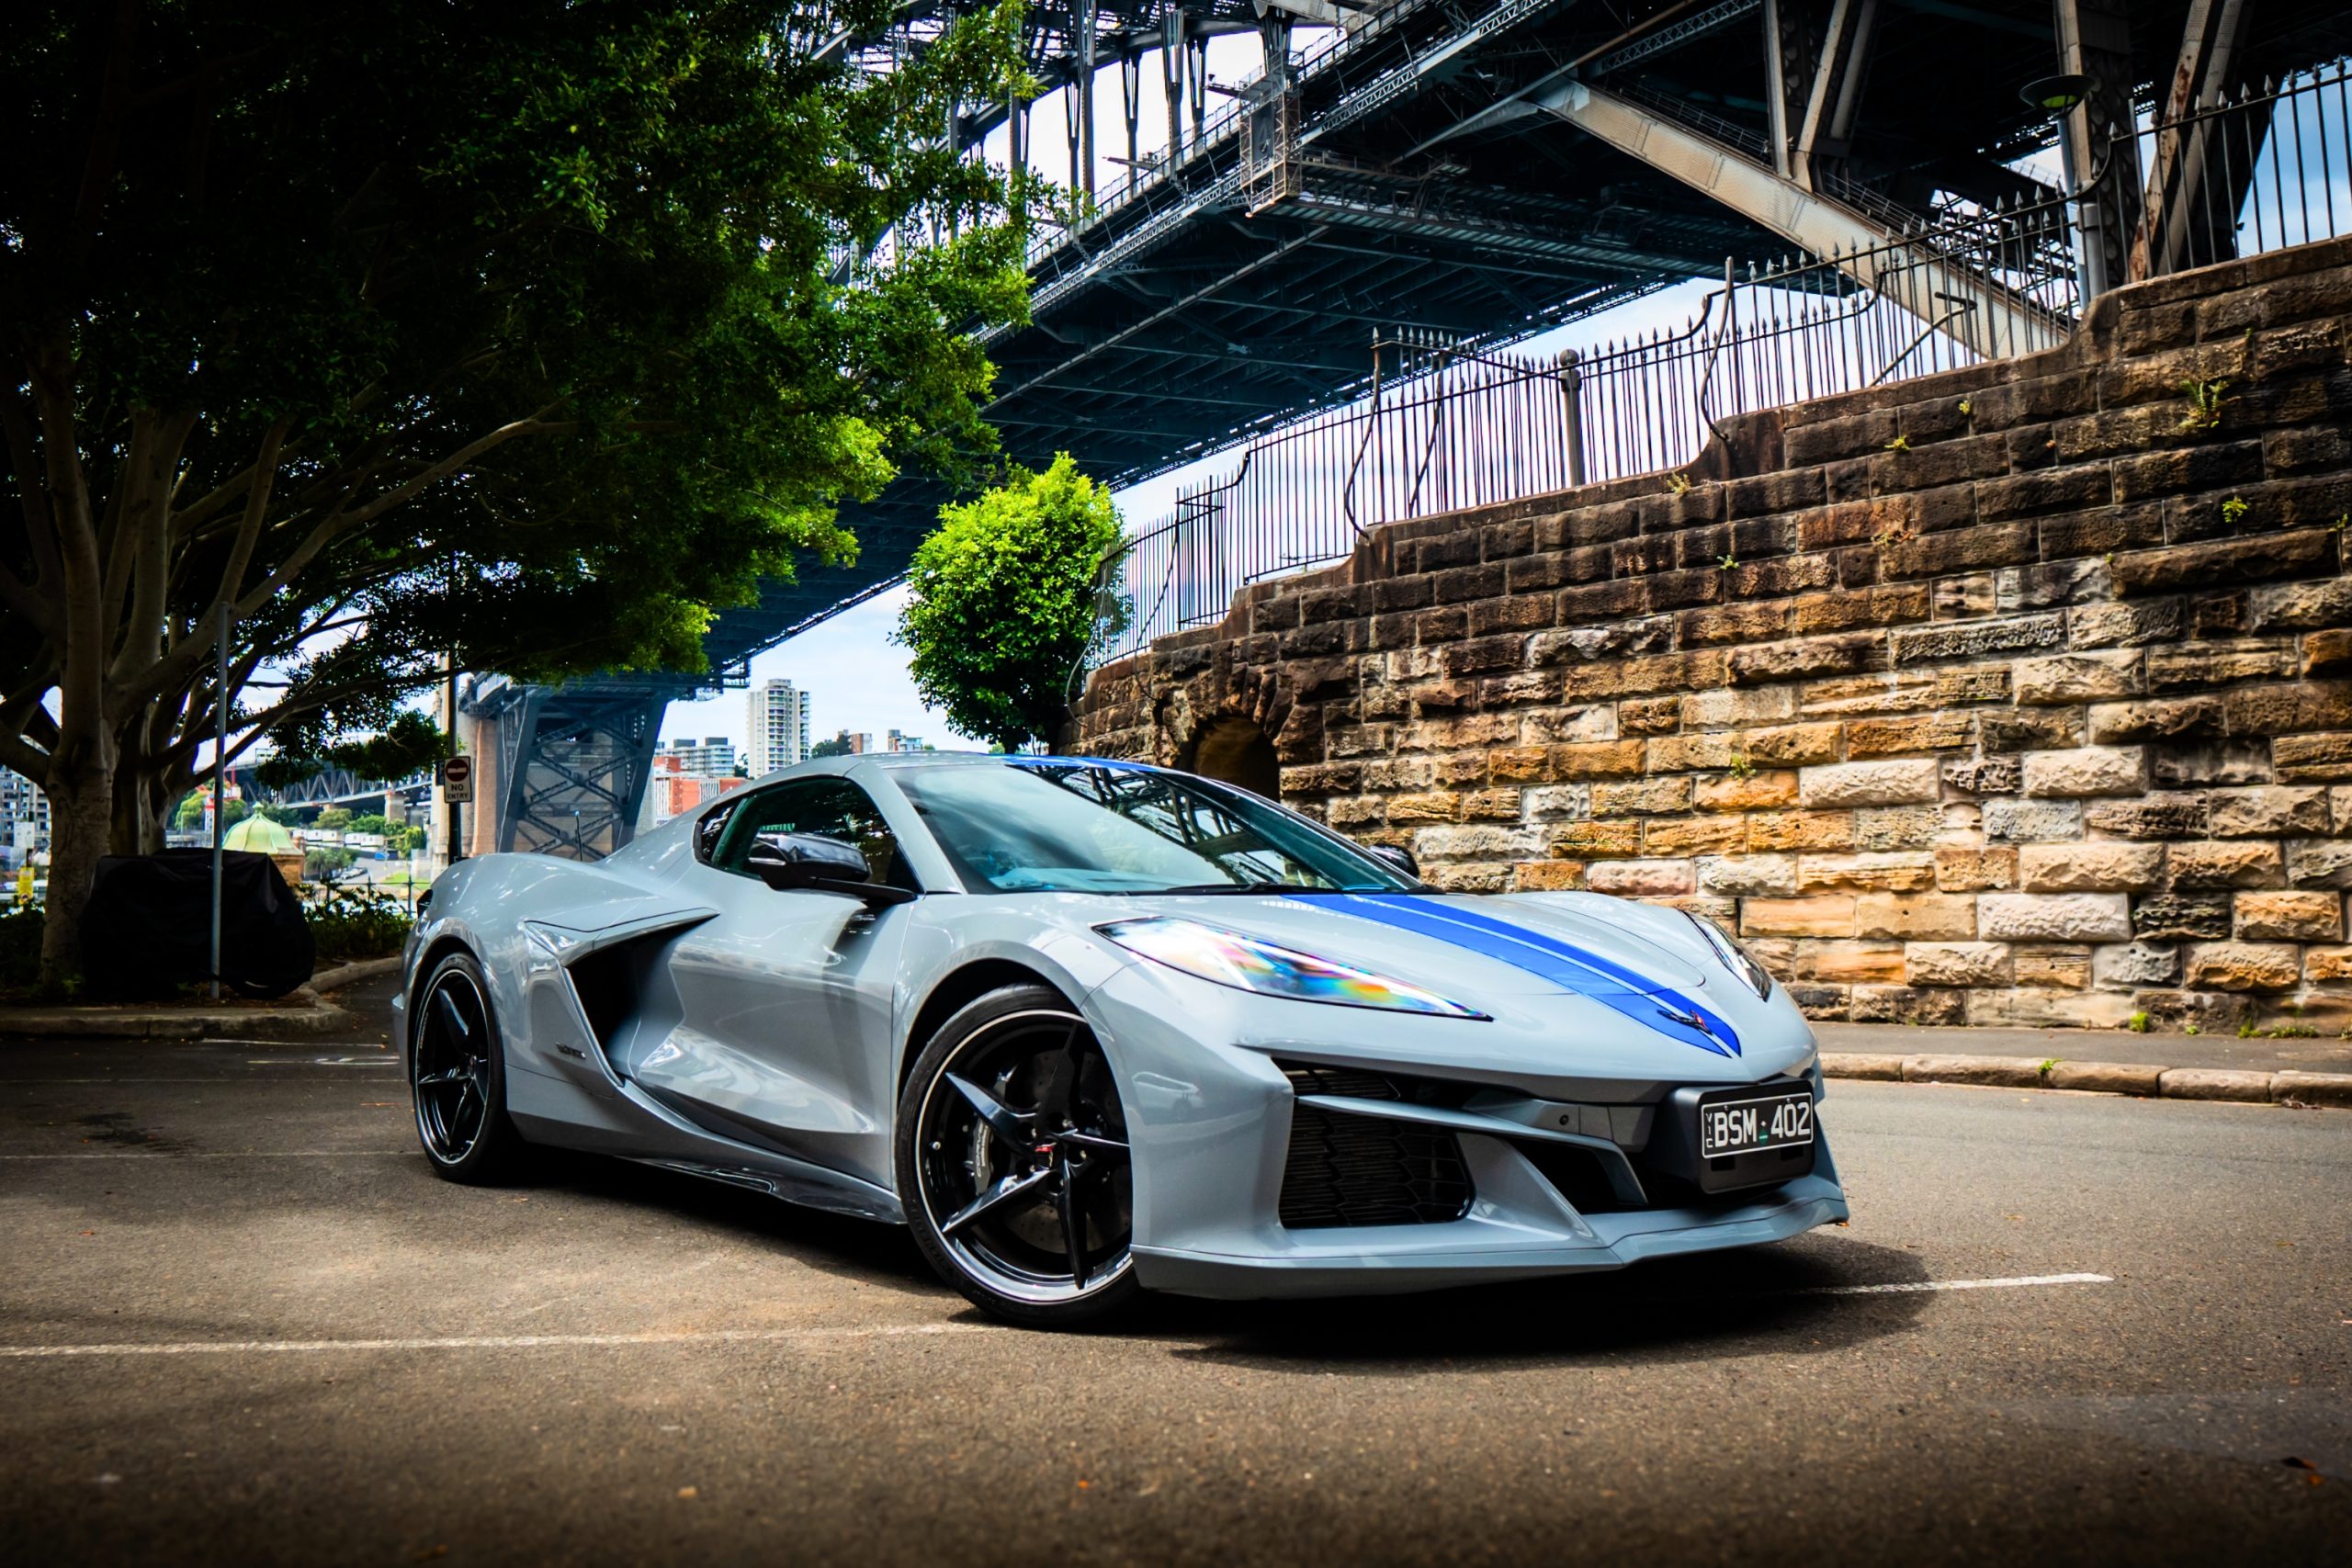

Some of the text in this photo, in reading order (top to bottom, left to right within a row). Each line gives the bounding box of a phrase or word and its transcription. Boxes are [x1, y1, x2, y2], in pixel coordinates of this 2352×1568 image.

[451, 784, 464, 792] NO
[1705, 1112, 1713, 1148] VIC
[1713, 1101, 1811, 1147] BSM 402
